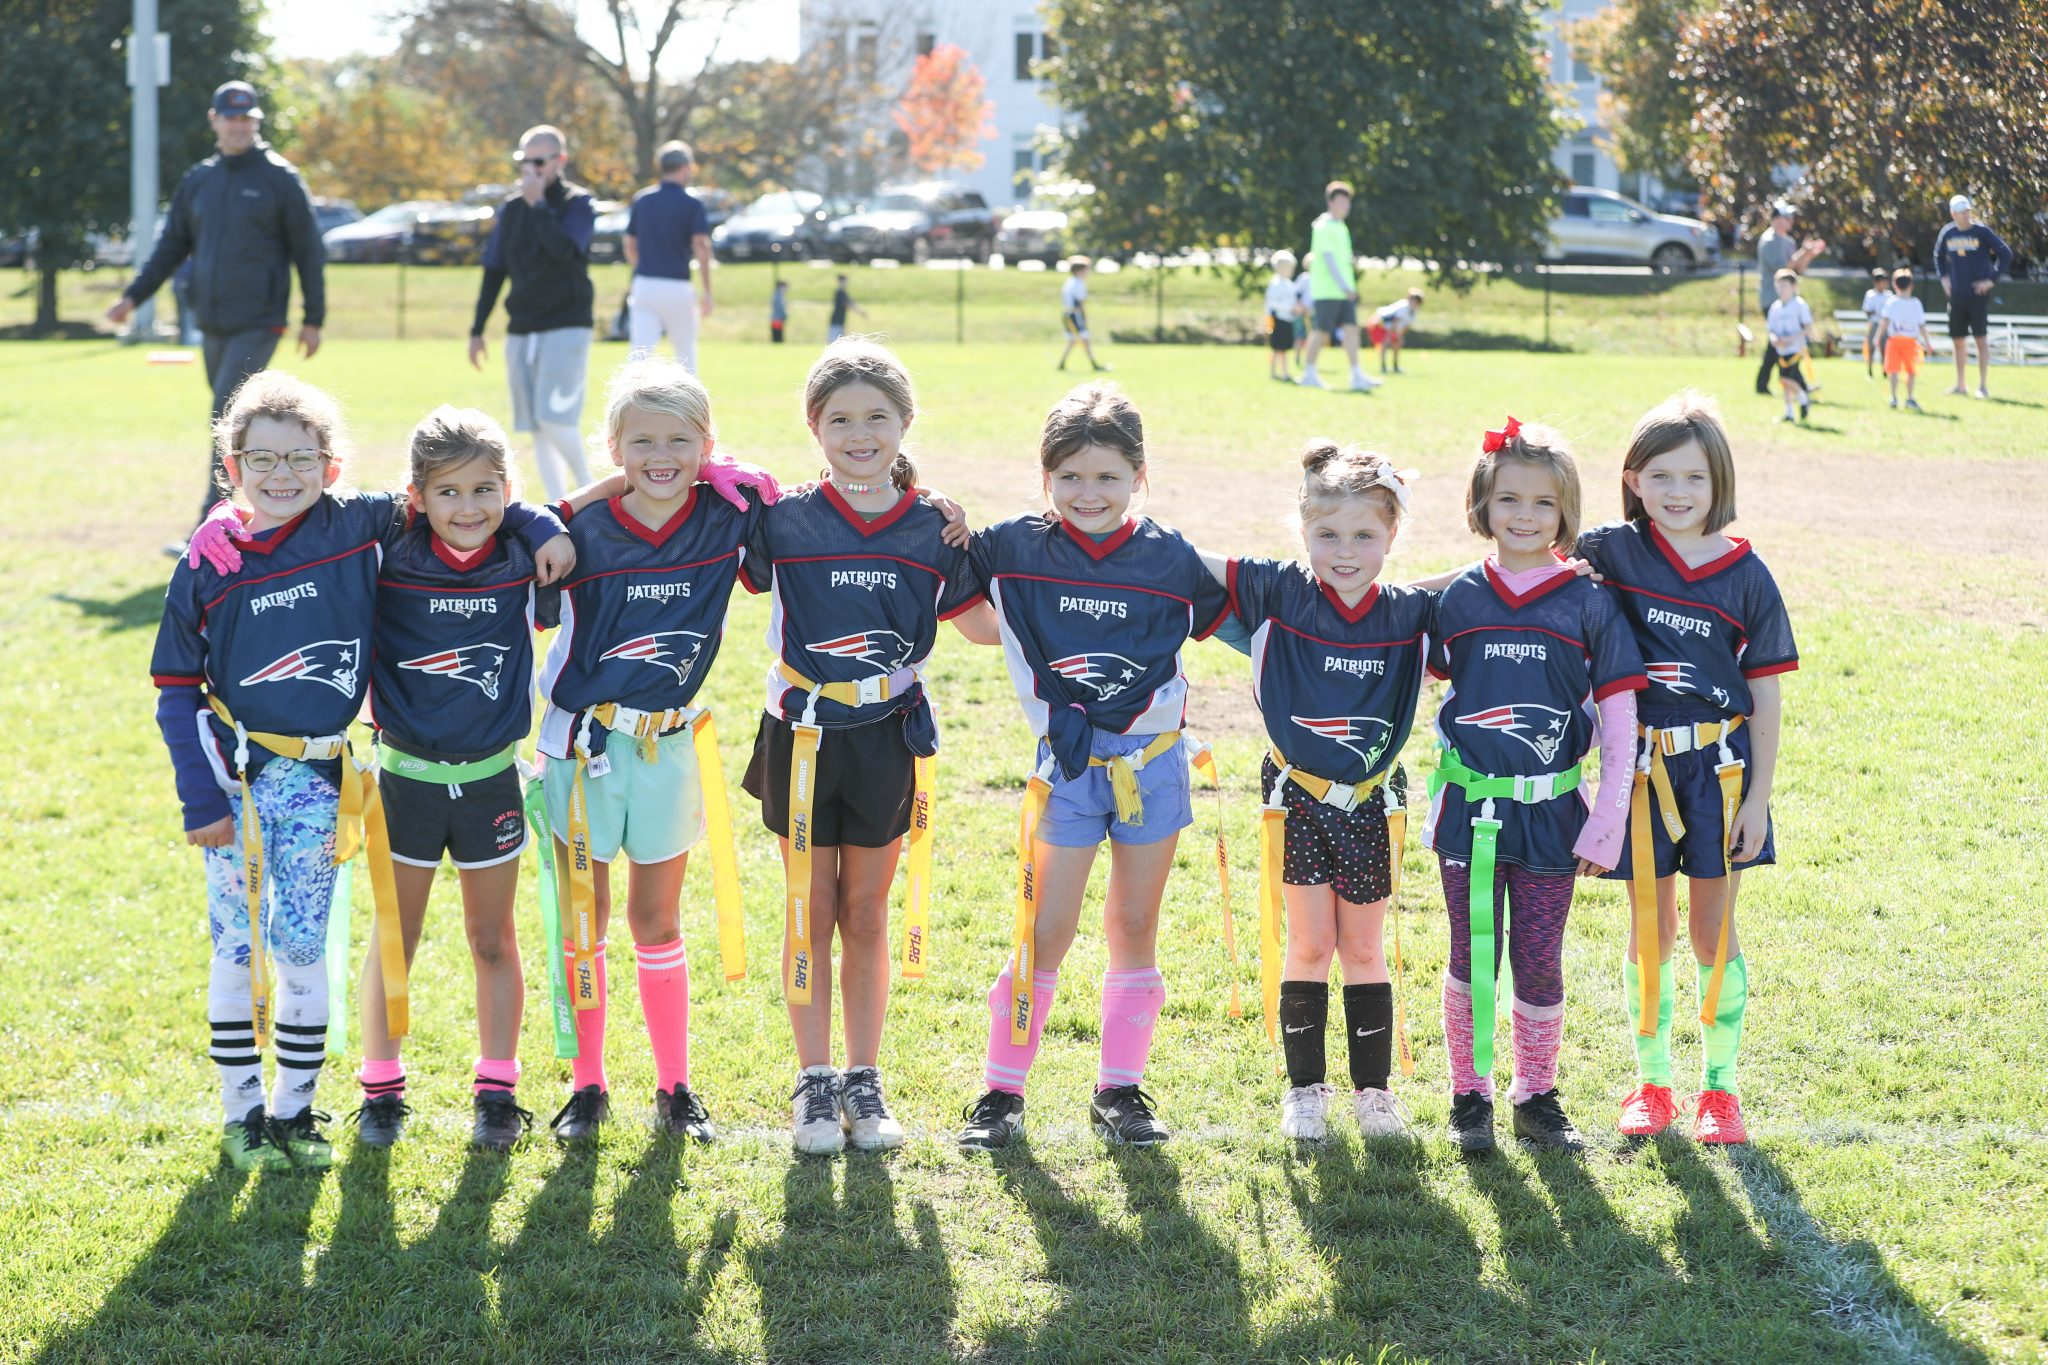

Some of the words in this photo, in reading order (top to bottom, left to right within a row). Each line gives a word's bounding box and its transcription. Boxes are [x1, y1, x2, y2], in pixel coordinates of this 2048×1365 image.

[627, 582, 691, 602] PATRIOTS
[831, 571, 897, 590] PATRIOTS
[250, 581, 318, 616] PATRIOTS
[429, 597, 497, 614] PATRIOTS
[1060, 596, 1128, 619] PATRIOTS
[1647, 607, 1712, 638] PATRIOTS
[1324, 656, 1385, 676] PATRIOTS
[1485, 643, 1547, 661] PATRIOTS
[398, 760, 428, 771] NERF
[797, 759, 808, 802] SUBWAY
[1616, 759, 1633, 809] vines
[794, 820, 807, 853] FLAG
[574, 840, 588, 871] FLAG
[248, 861, 259, 894] FLAG
[1023, 871, 1033, 902] FLAG
[795, 897, 804, 940] SUBWAY
[908, 934, 922, 965] FLAG
[578, 967, 592, 999] FLAG
[795, 957, 808, 990] FLAG
[1017, 1000, 1029, 1031] FLAG
